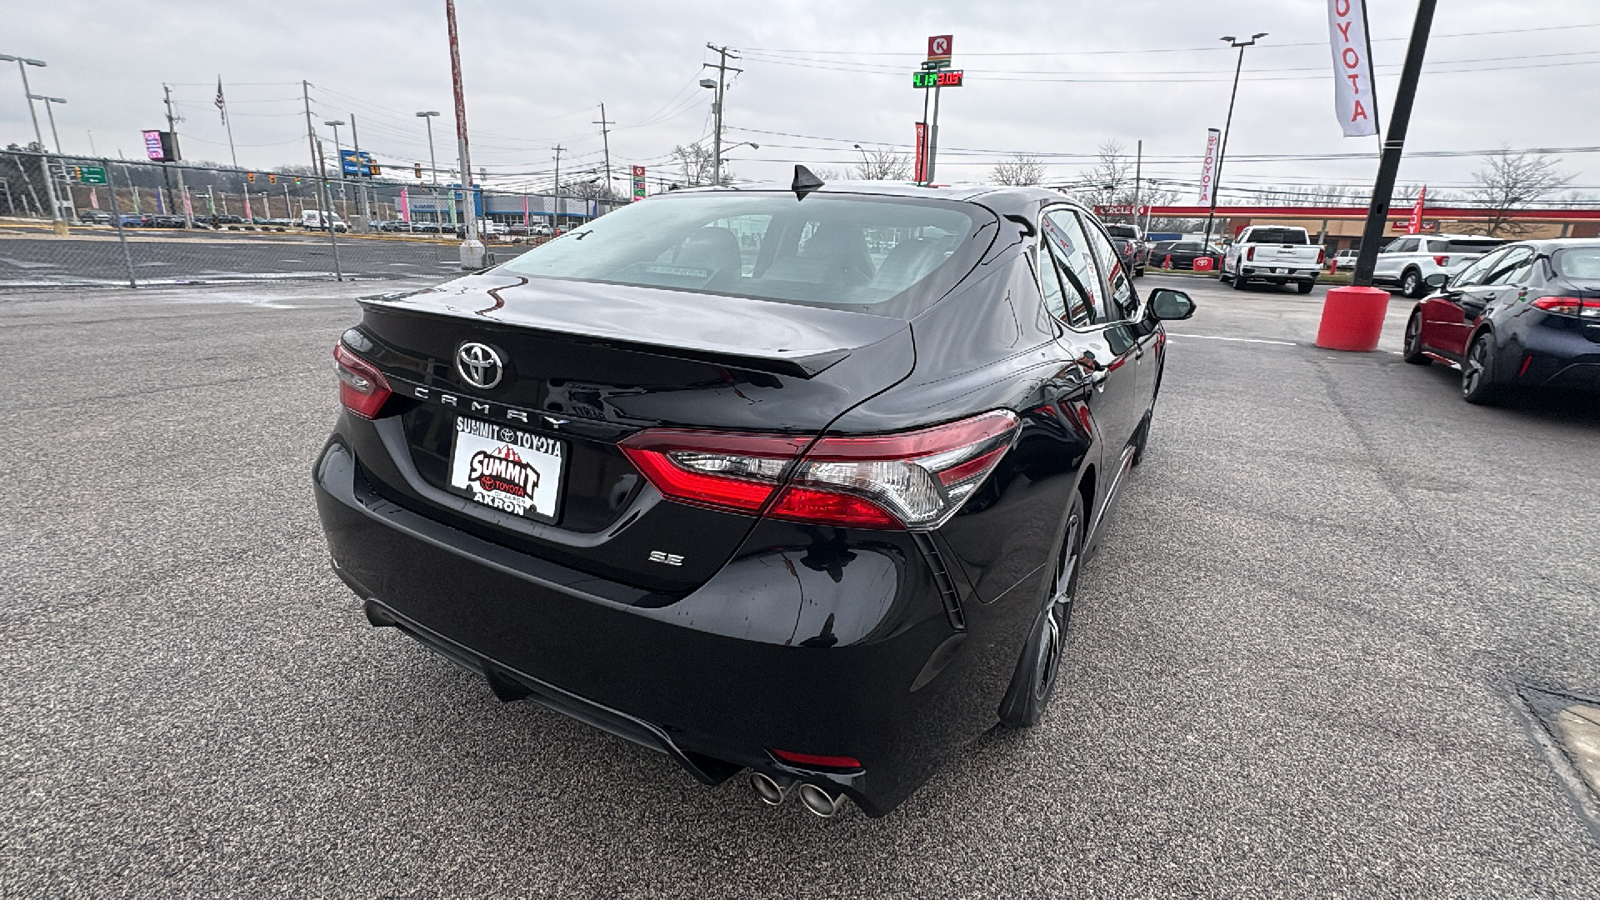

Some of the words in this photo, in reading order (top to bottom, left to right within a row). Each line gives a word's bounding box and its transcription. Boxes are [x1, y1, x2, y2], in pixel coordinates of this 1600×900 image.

[1200, 148, 1213, 201] TOYOTA
[414, 387, 570, 429] CAMRY
[456, 416, 499, 441] SUMMIT
[516, 432, 562, 458] TOYOTA
[470, 452, 538, 496] SUMMIT
[495, 480, 525, 497] TOYOTA
[473, 492, 525, 515] AKRON
[504, 494, 526, 505] AKRON
[648, 551, 685, 566] SE
